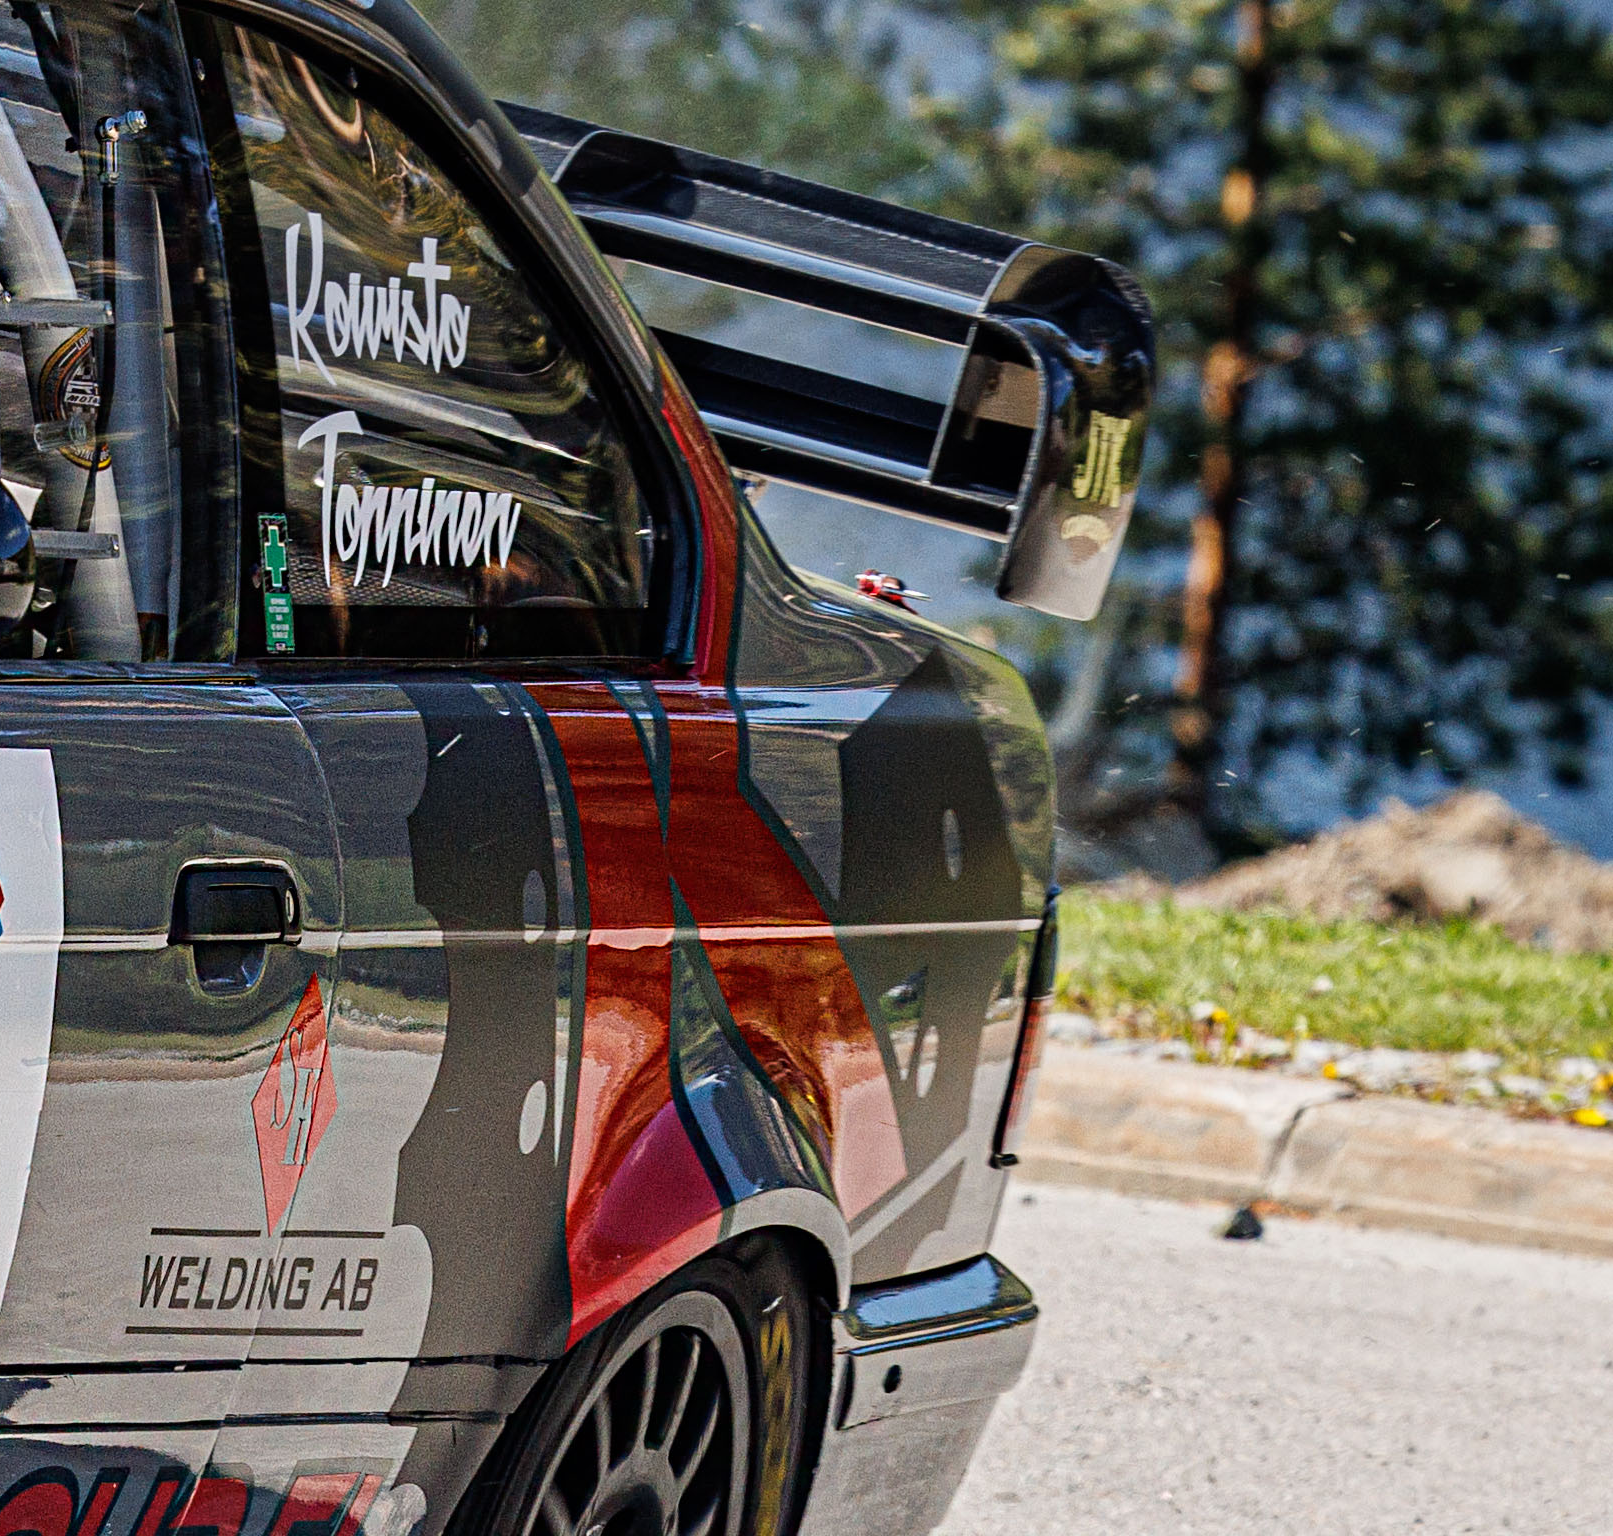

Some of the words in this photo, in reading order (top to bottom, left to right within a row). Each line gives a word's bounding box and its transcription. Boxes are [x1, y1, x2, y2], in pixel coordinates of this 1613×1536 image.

[286, 212, 471, 386] Koivisto
[139, 1254, 315, 1311] WELDING
[320, 1257, 380, 1312] AB
